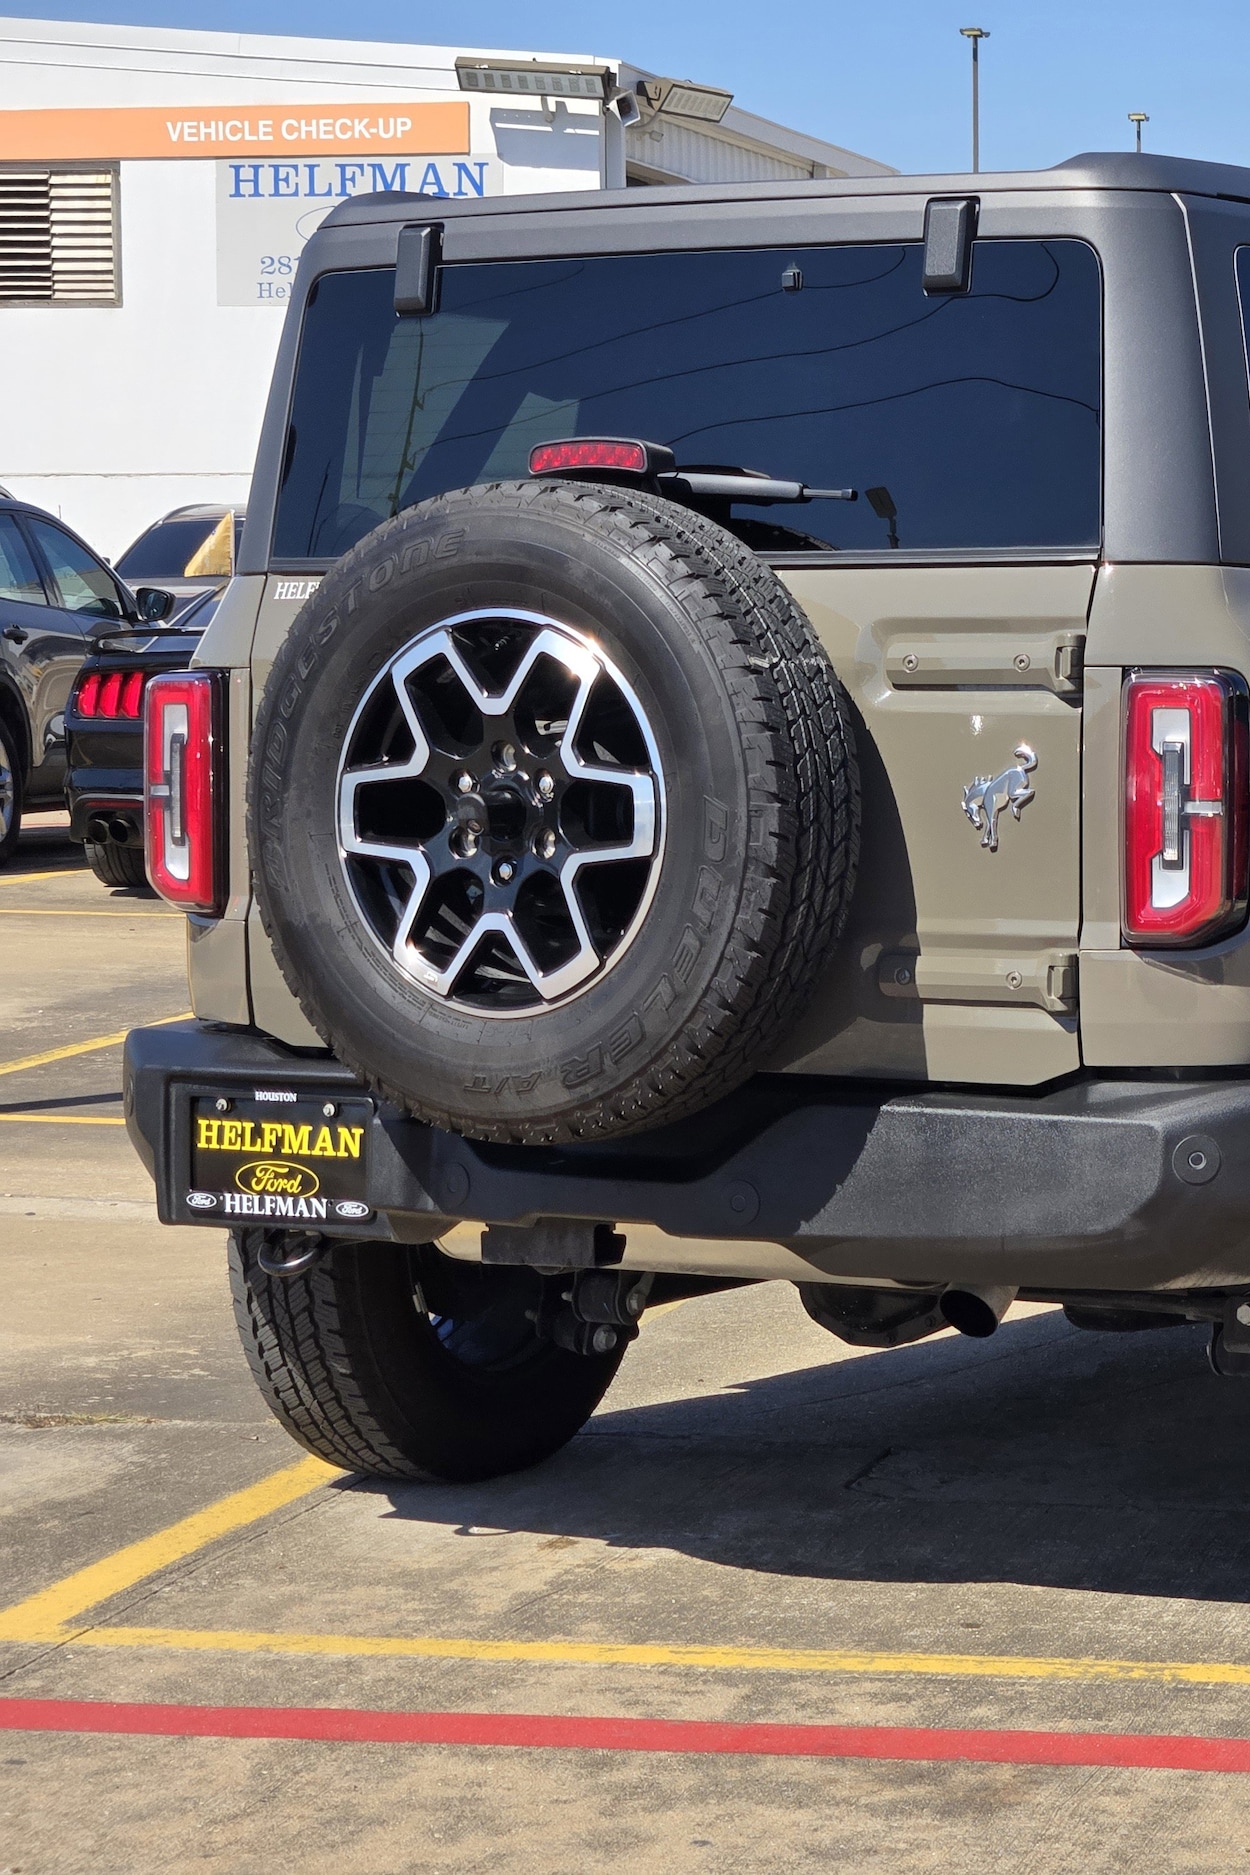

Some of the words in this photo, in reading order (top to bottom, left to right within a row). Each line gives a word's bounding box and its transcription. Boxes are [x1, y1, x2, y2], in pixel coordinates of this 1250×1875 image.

[166, 119, 274, 142] VEHICLE
[281, 117, 412, 140] CHECK-UP
[229, 162, 489, 198] HELFMAN
[254, 1091, 298, 1103] HOUSTON
[197, 1118, 365, 1159] HELFMAN
[251, 1164, 303, 1194] Ford
[190, 1194, 213, 1206] Ford
[223, 1192, 328, 1220] HELFMAN
[341, 1205, 365, 1217] Ford
